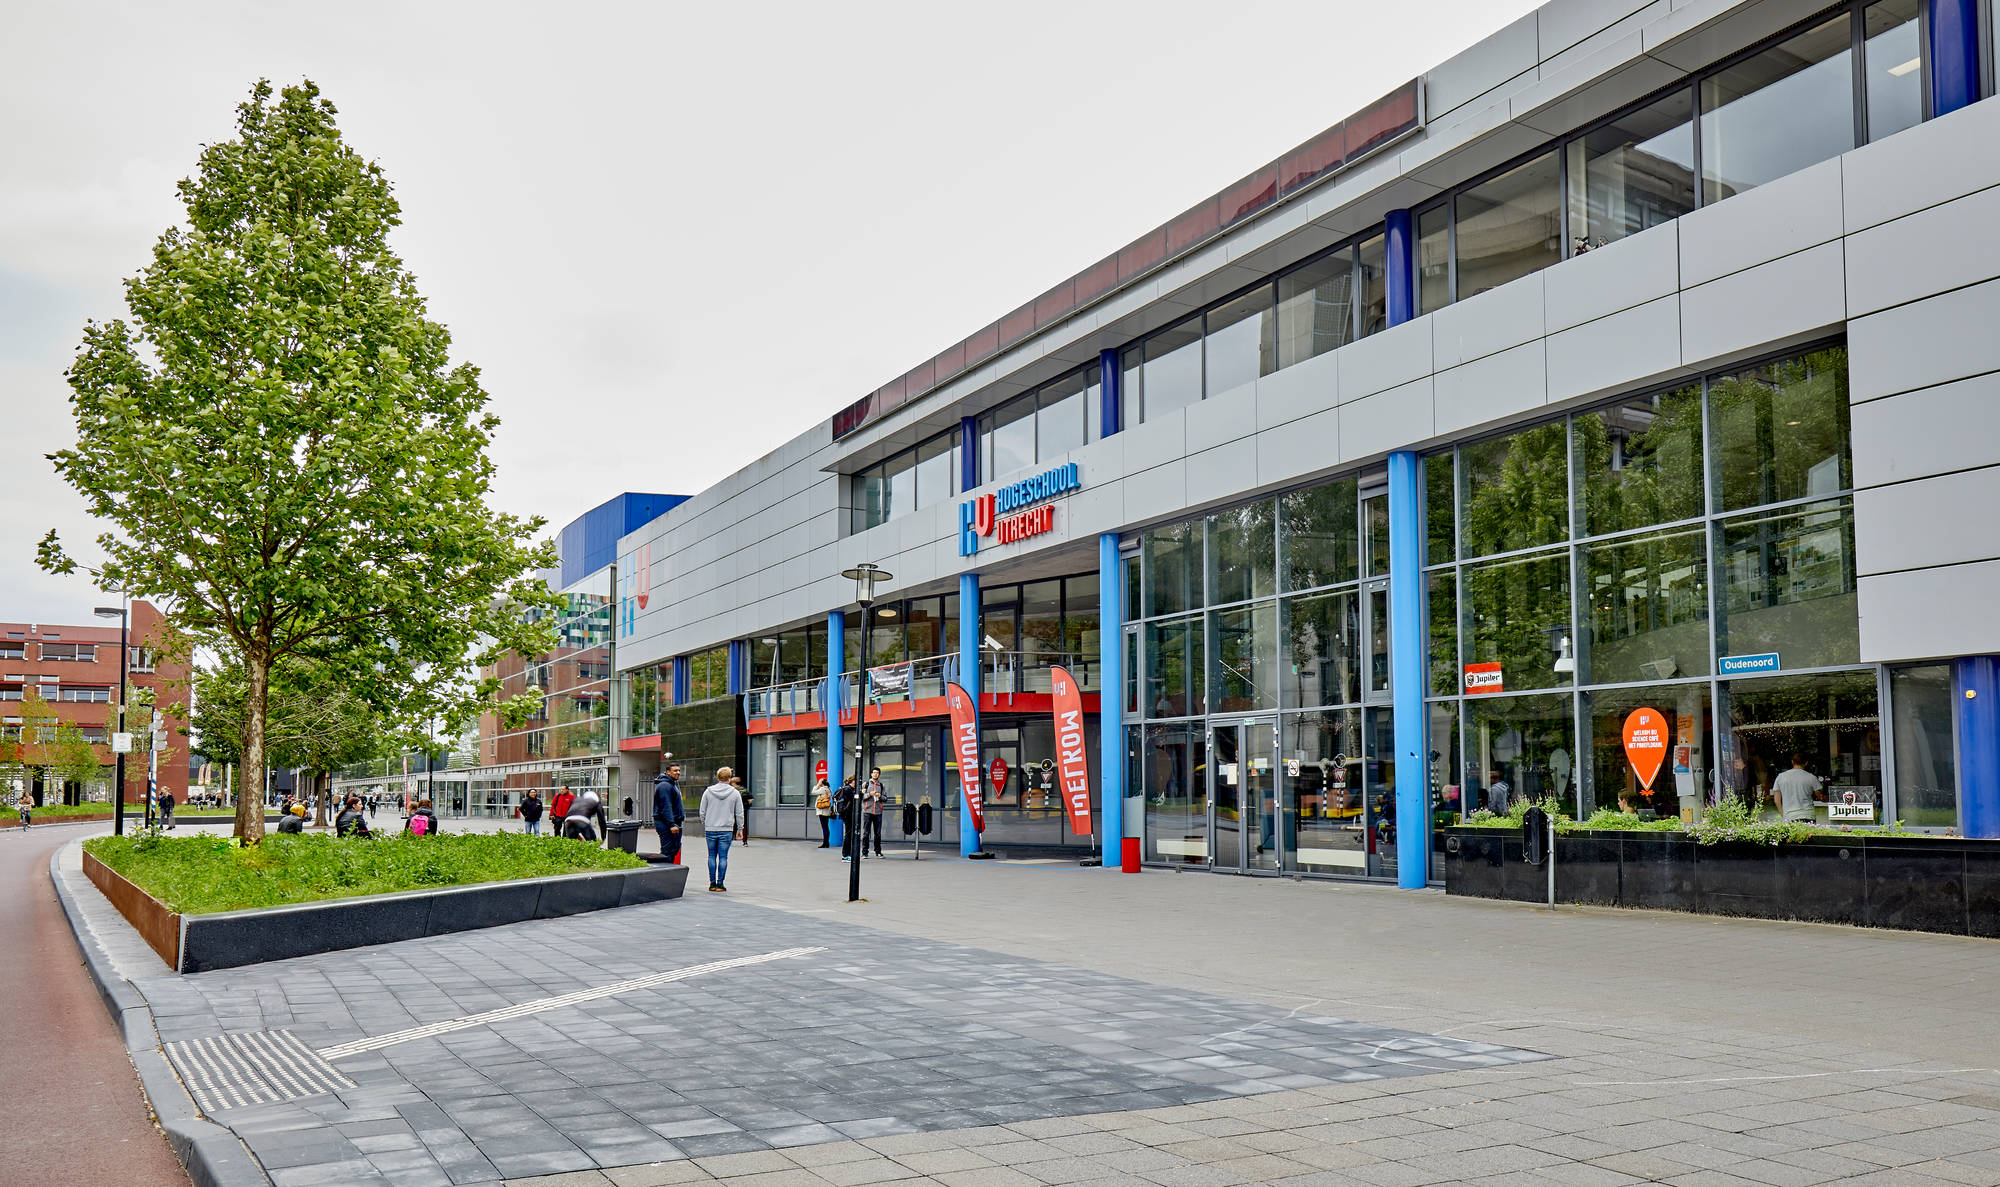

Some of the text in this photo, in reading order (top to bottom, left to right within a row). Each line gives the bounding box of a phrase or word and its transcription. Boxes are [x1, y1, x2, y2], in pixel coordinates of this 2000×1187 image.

[997, 463, 1081, 513] HOGESCHOOL
[959, 494, 994, 557] HU
[996, 505, 1055, 545] UTRECHT
[1725, 657, 1774, 669] Oudenoord
[1475, 674, 1500, 683] Jupiler
[1831, 806, 1871, 817] Jupiler
